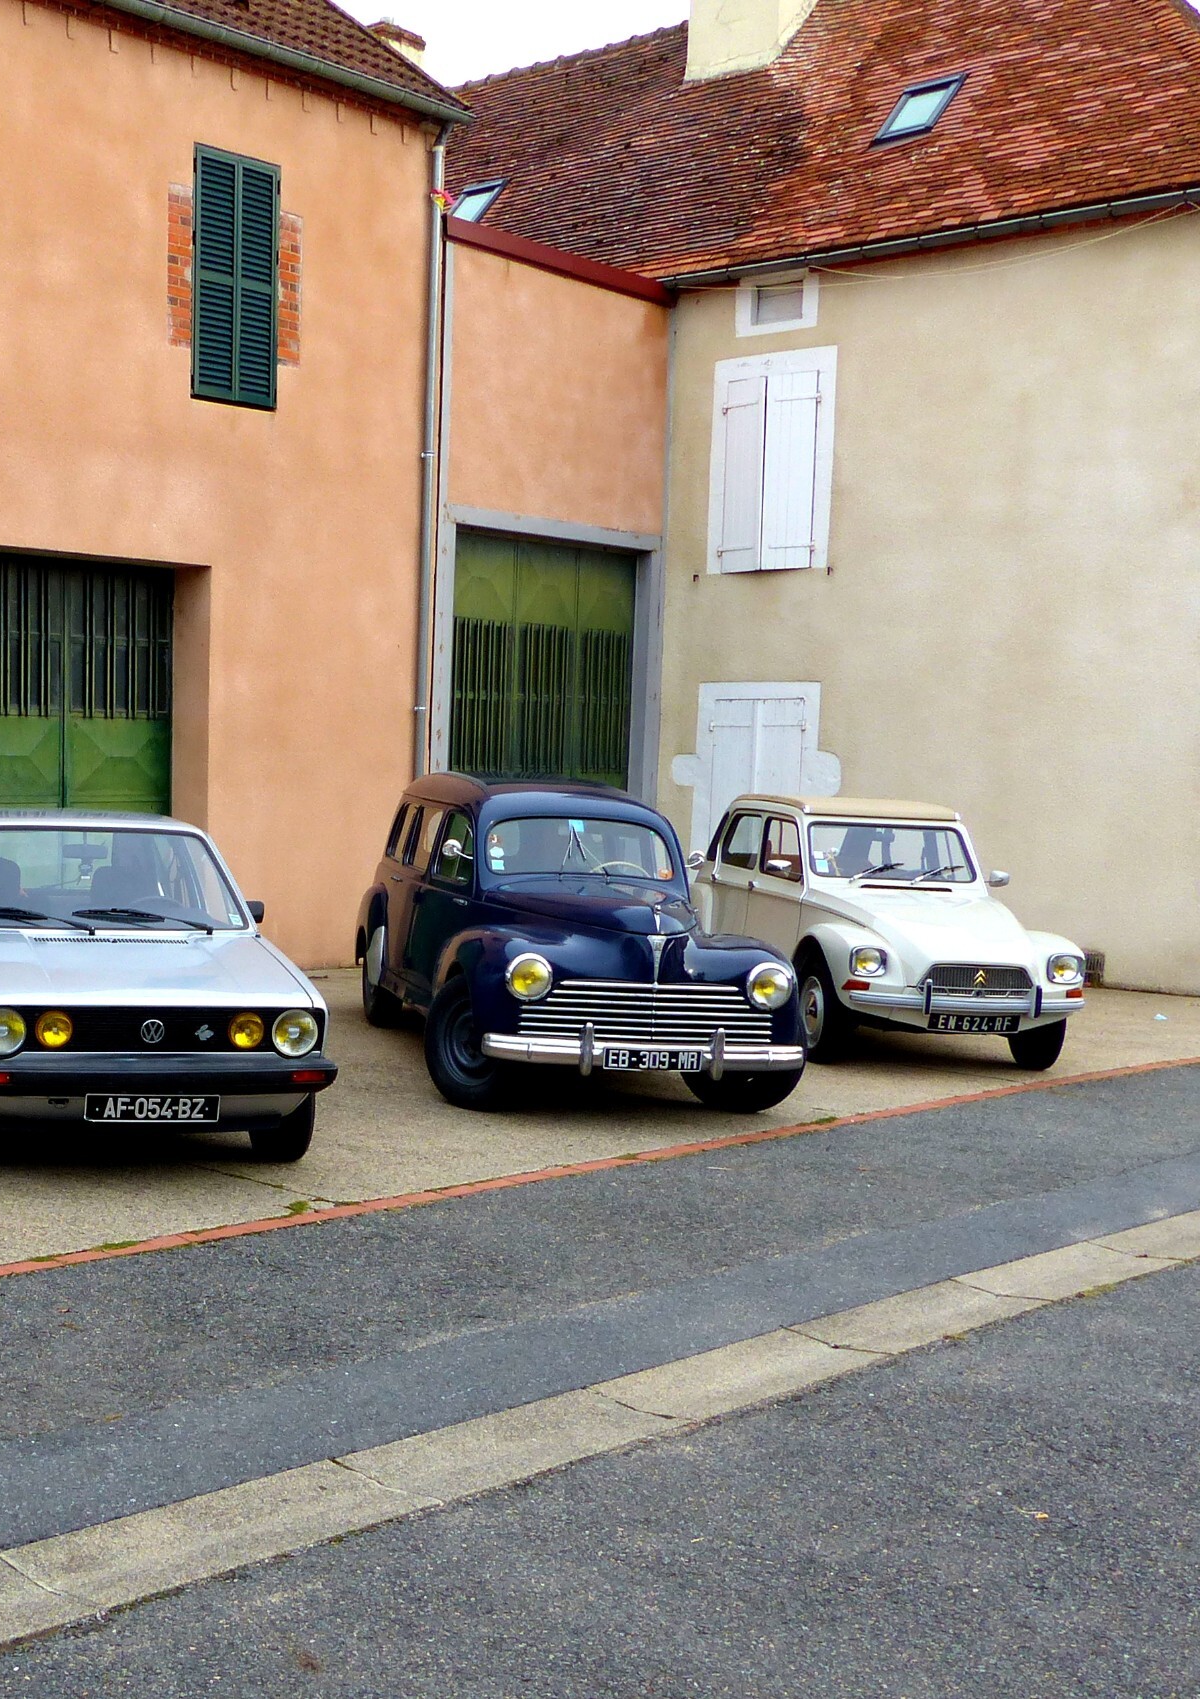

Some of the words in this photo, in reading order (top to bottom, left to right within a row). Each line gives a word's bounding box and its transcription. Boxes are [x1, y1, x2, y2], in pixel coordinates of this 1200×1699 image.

[937, 1014, 1012, 1031] EN-624-RF
[608, 1049, 698, 1069] EB-309-MR
[103, 1097, 204, 1119] AF-054-BZ
